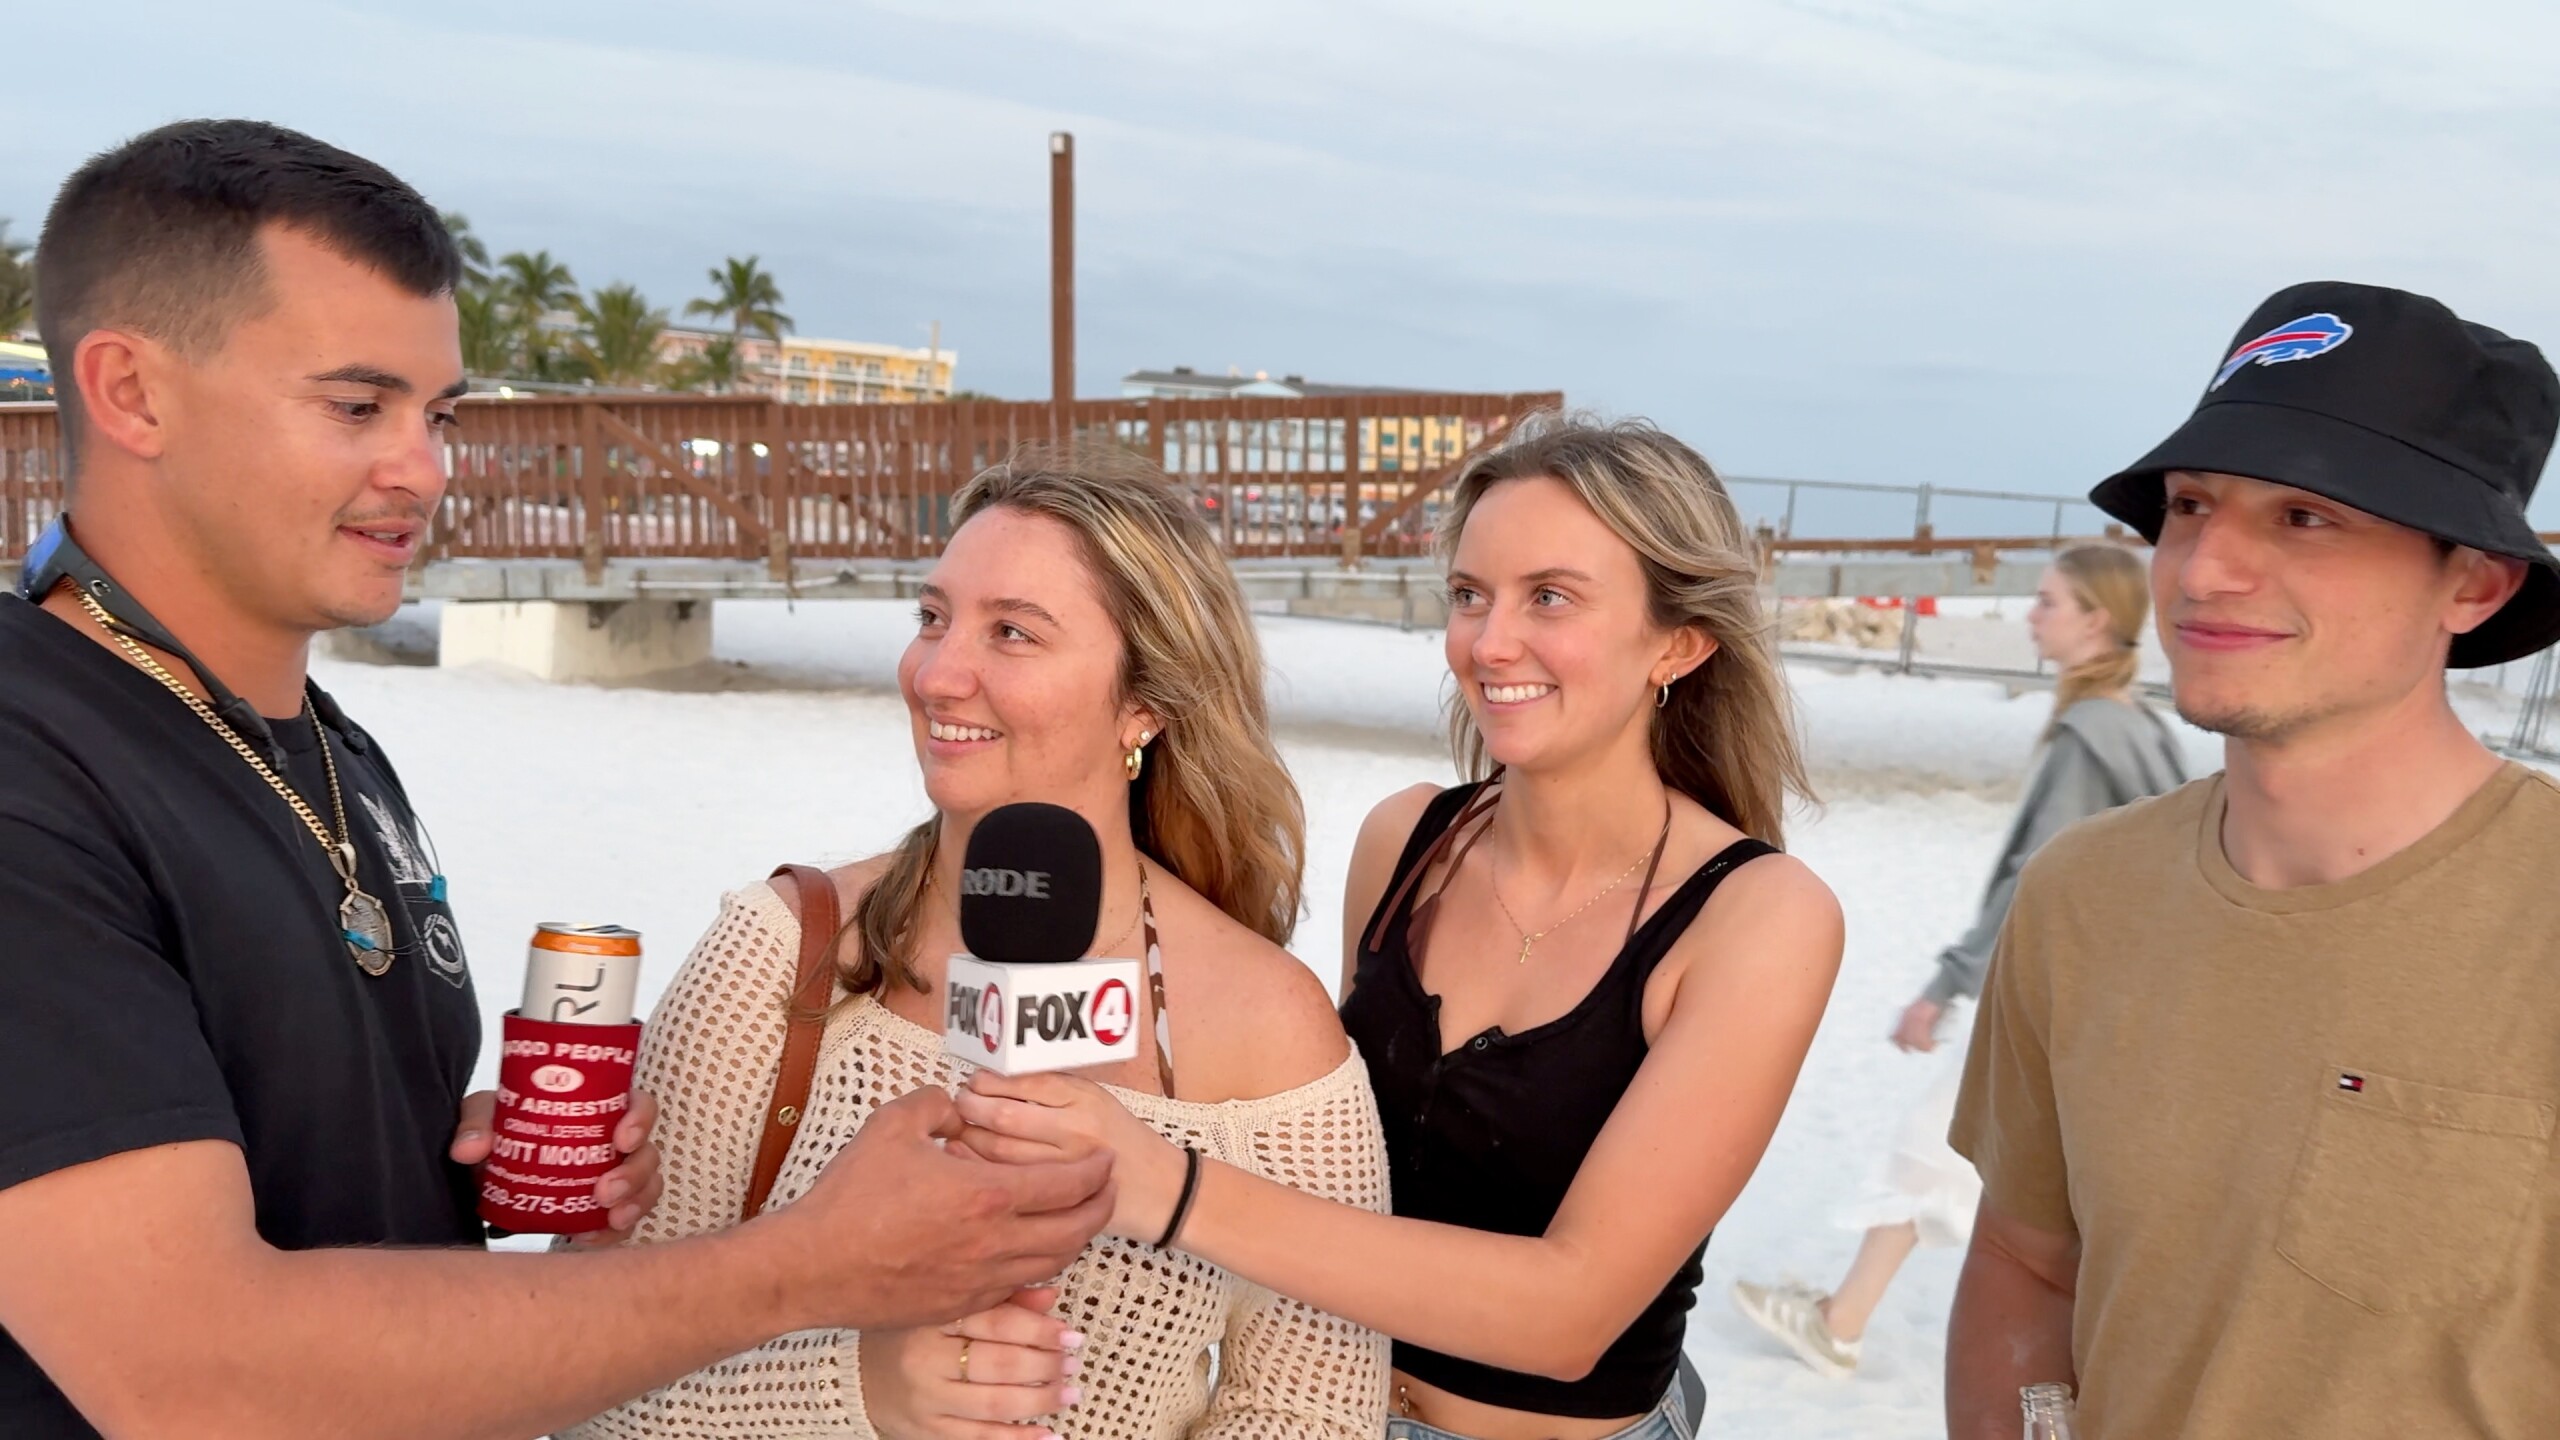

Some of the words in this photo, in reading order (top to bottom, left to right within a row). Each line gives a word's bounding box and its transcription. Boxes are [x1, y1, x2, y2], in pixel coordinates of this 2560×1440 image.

[1015, 991, 1089, 1047] FOX
[1092, 985, 1131, 1038] 4
[551, 1125, 606, 1138] DEFENSE
